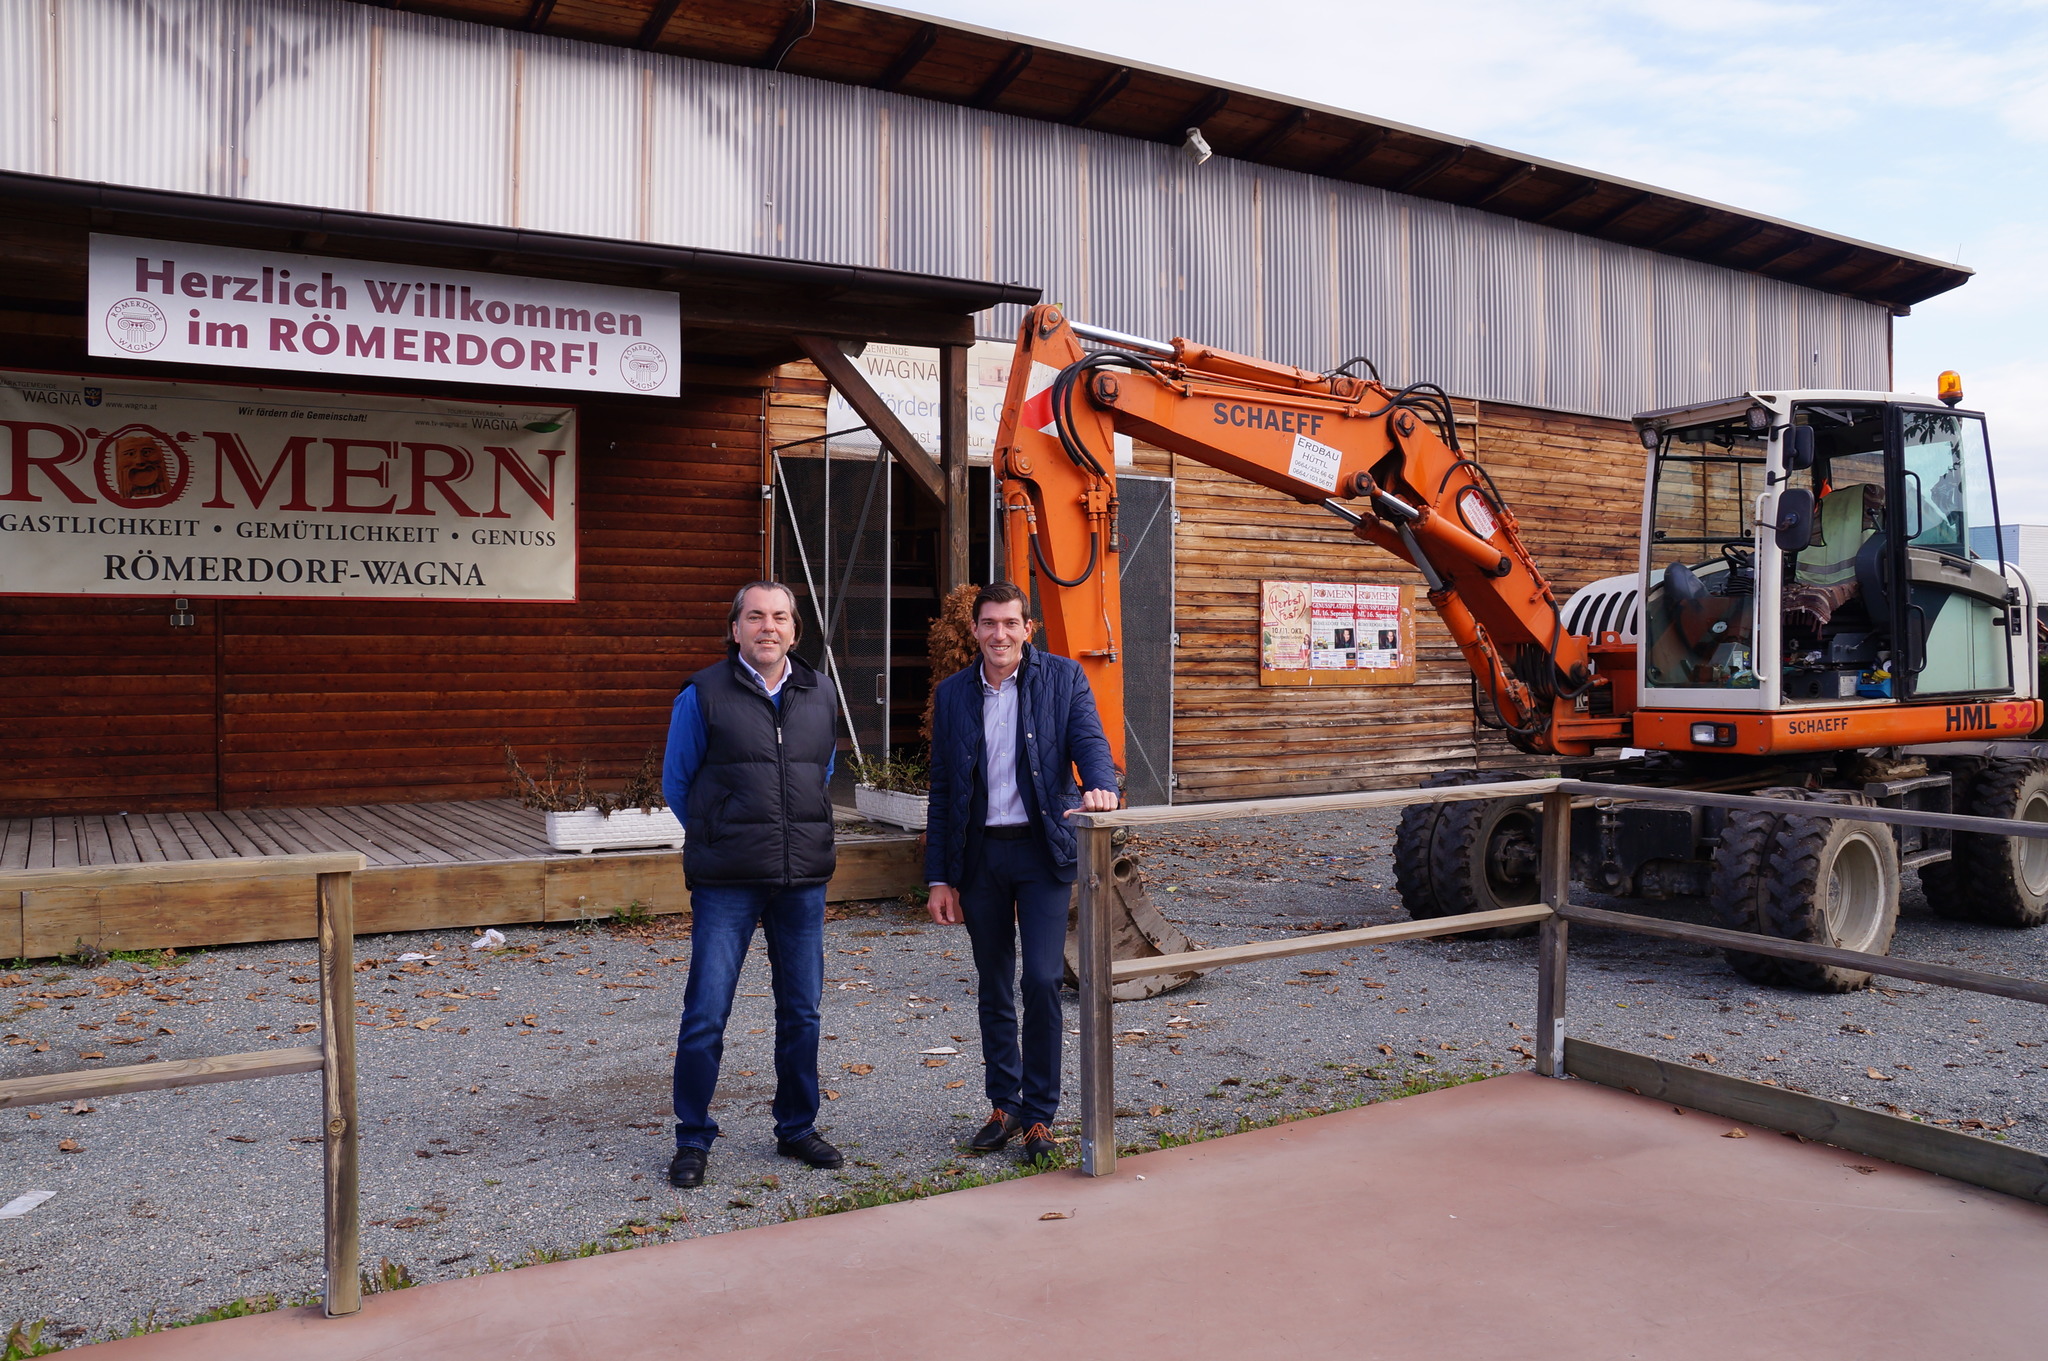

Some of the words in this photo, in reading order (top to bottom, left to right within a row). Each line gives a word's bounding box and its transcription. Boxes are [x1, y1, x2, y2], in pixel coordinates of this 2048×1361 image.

[135, 257, 348, 311] Herzlich
[363, 280, 643, 338] Willkommen
[111, 300, 163, 322] RÖMERDORF
[119, 337, 156, 351] WAGNA
[188, 308, 248, 349] im
[269, 313, 598, 376] RÖMERDORF!
[866, 357, 939, 382] WAGNA
[630, 377, 658, 389] WAGNA
[22, 390, 82, 406] WAGNA
[105, 400, 157, 411] www.wagna.at
[238, 406, 254, 416] Wir
[256, 408, 288, 418] fördern
[290, 409, 304, 419] die
[306, 411, 368, 422] Gemeinschaft!
[968, 400, 986, 422] ie
[1213, 402, 1324, 436] SCHAEFF
[472, 418, 519, 431] WAGNA
[1297, 437, 1340, 461] ERDBAU
[1302, 451, 1328, 469] HÜTTL
[0, 420, 566, 521] RÖMERN
[0, 513, 201, 538] GASTLICHKEIT
[236, 519, 440, 544] GEMÜTLICHKEIT
[472, 528, 557, 547] GENUSS
[104, 549, 487, 587] RÖMERDORF-WAGNA
[1270, 592, 1303, 611] Herbst
[1278, 606, 1299, 621] Fest
[1788, 716, 1849, 735] SCHAEFF
[1945, 704, 1997, 732] HML
[2002, 703, 2034, 730] 32
